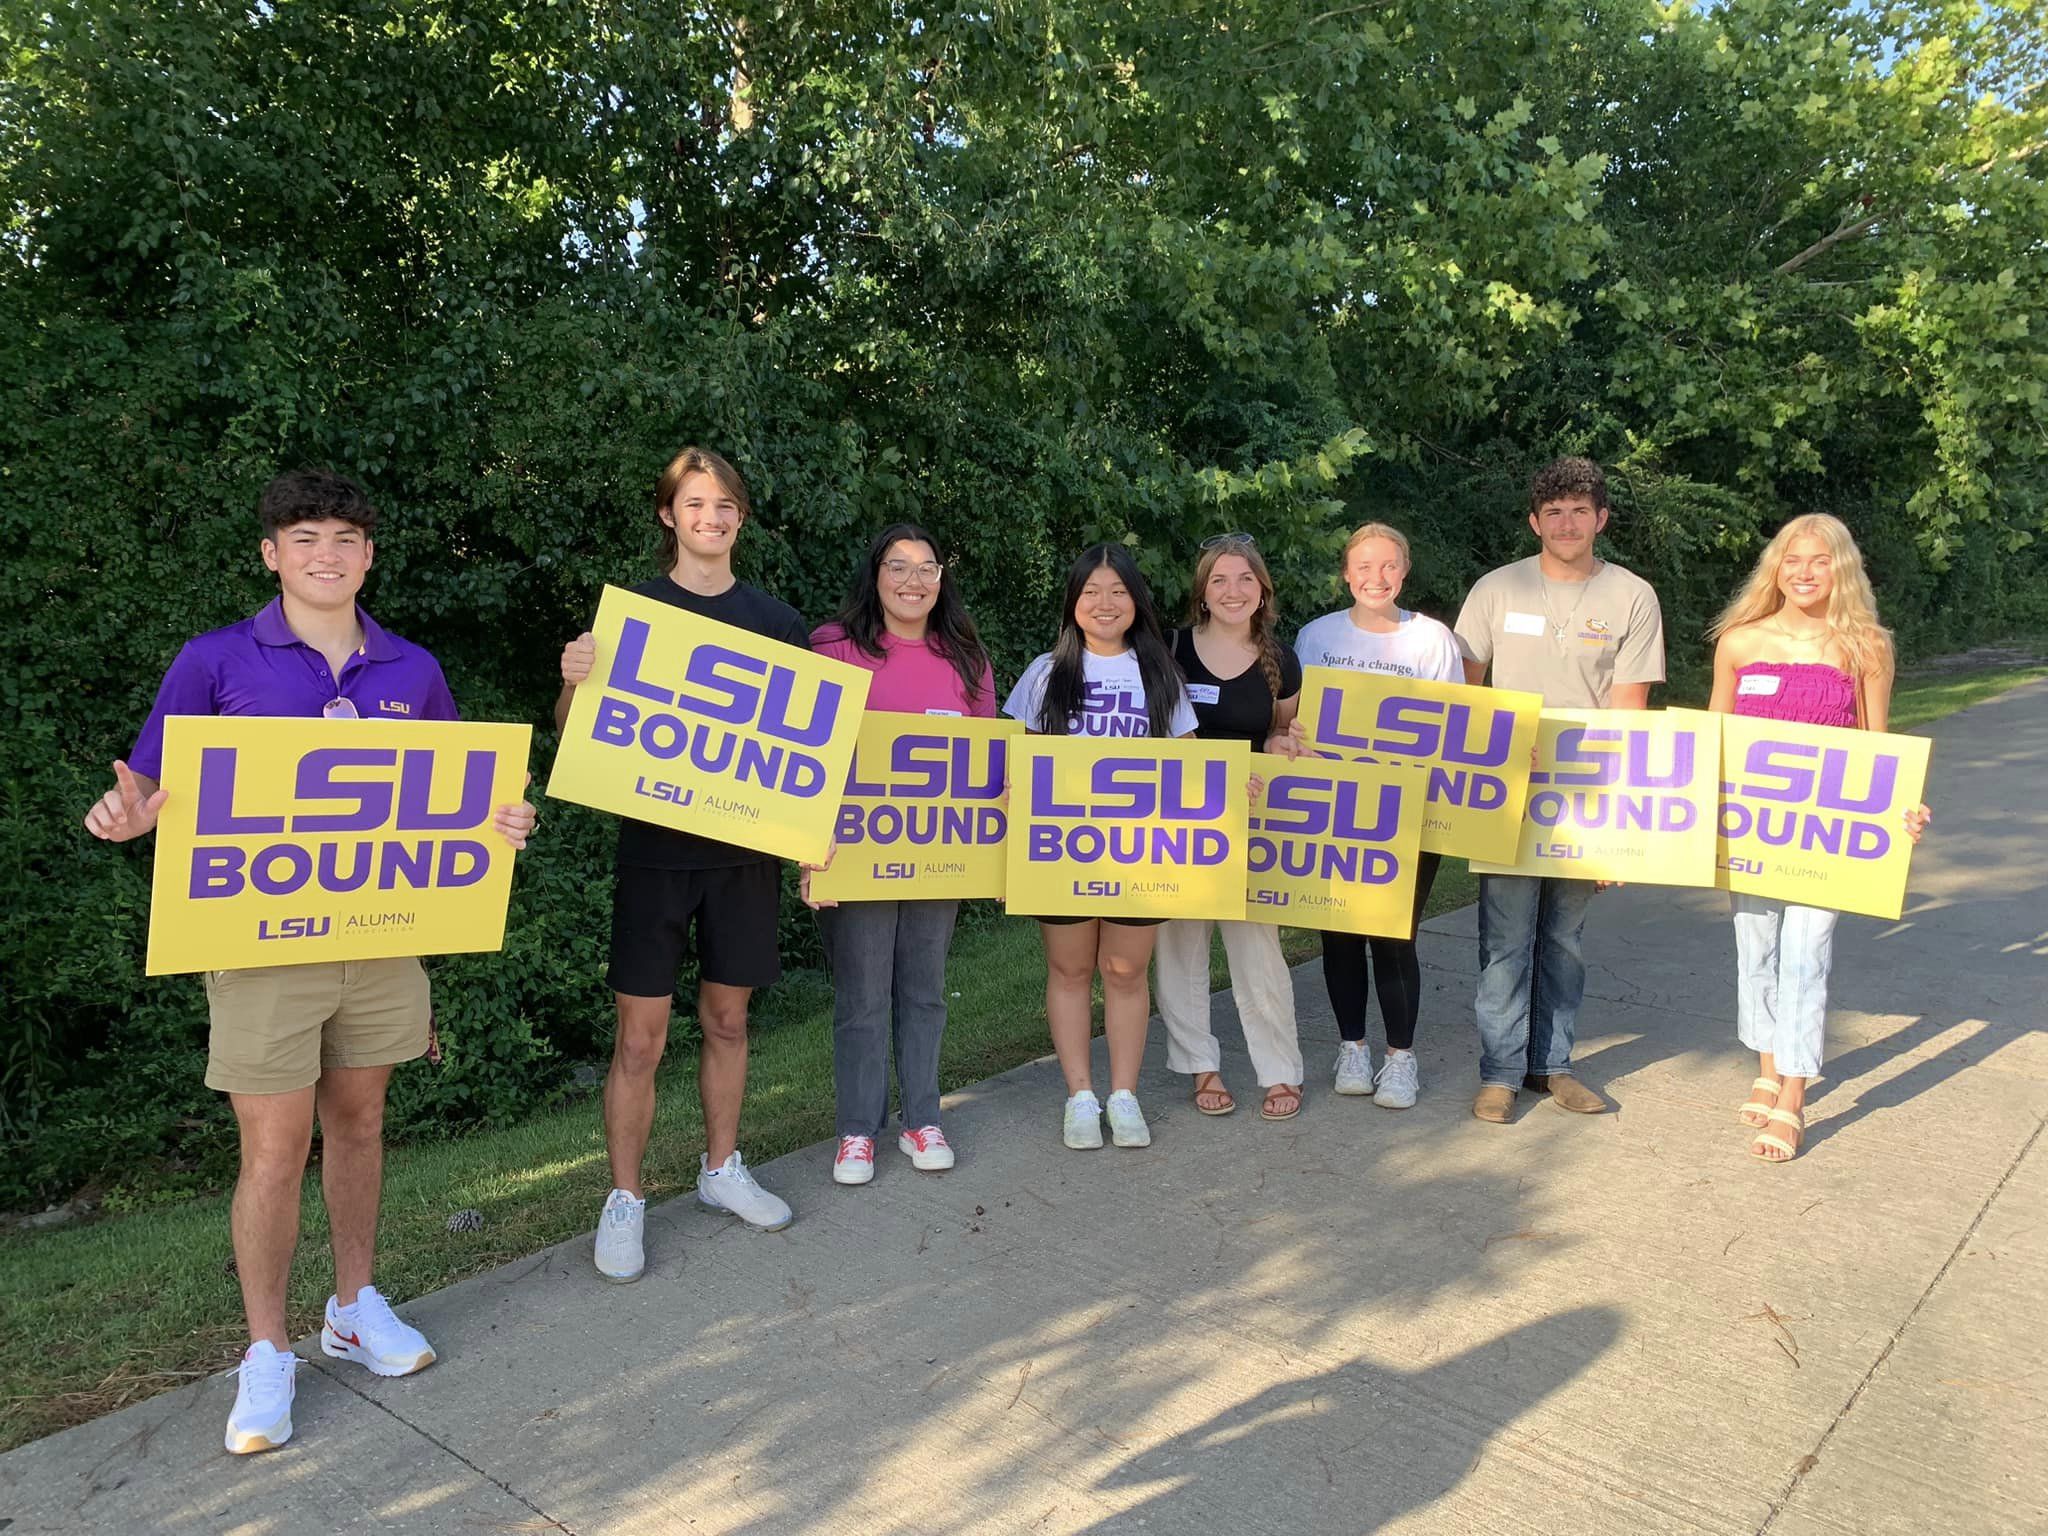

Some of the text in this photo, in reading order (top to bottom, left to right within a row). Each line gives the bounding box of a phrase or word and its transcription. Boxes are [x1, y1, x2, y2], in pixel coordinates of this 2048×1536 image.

[607, 617, 843, 747] LSU
[1321, 652, 1414, 677] Spark a change,
[379, 700, 410, 714] LSU
[1066, 713, 1149, 738] OUND
[1315, 686, 1516, 768] LSU
[591, 696, 826, 798] BOUND
[843, 734, 1006, 799] LSU
[1529, 728, 1695, 788] SU
[196, 747, 497, 835] LSU
[635, 776, 694, 807] LSU
[704, 795, 760, 819] ALUMNI
[1031, 755, 1227, 821] LSU
[1719, 740, 1899, 814] SU
[834, 804, 1008, 845] BOUND
[1248, 775, 1402, 842] SU
[1523, 790, 1698, 832] OUND
[1028, 824, 1230, 866] BOUND
[1536, 843, 1584, 859] LSU
[1717, 802, 1891, 860] OUND
[189, 840, 490, 899] BOUND
[873, 863, 915, 879] LSU
[924, 863, 966, 873] ALUMNI
[1247, 837, 1399, 884] OUND
[1775, 864, 1828, 880] ALUMNI
[1073, 880, 1179, 897] LSU ALUMNI
[1299, 894, 1346, 907] ALUMNI
[258, 916, 331, 940] LSU
[346, 912, 415, 927] ALUMNI
